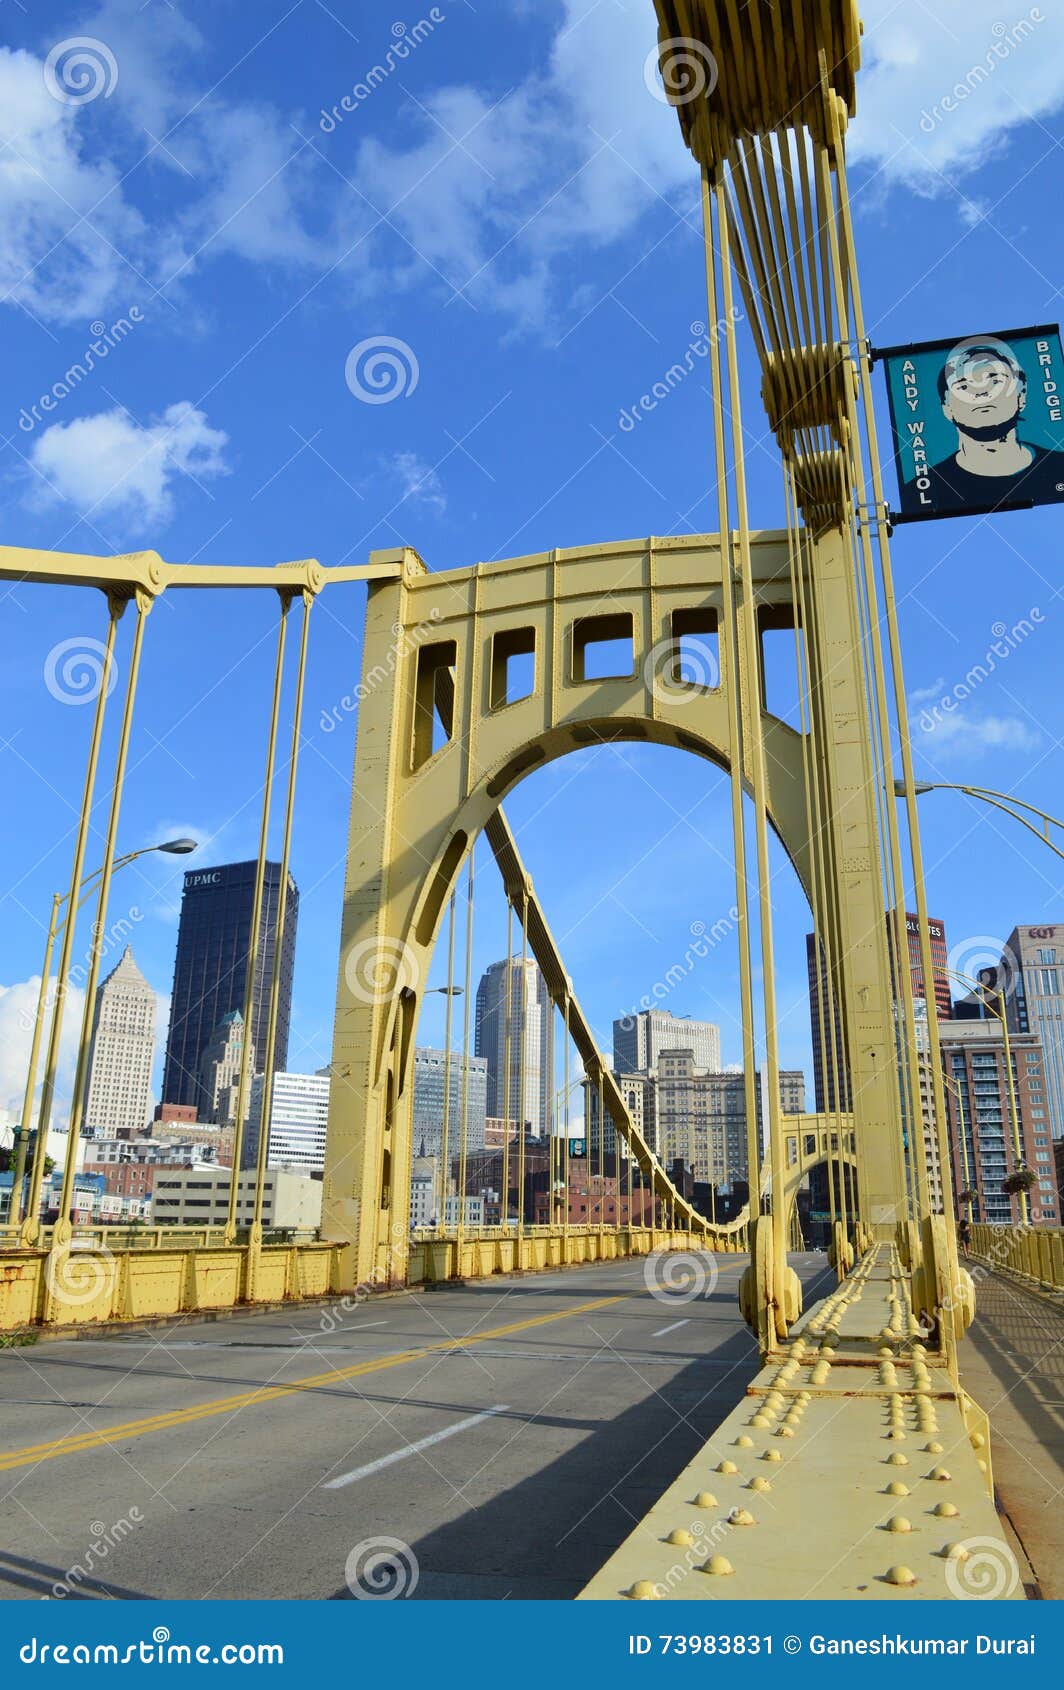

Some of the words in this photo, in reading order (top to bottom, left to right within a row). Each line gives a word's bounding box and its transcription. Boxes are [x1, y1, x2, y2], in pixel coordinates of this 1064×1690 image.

[902, 360, 920, 412] ANDY
[1036, 341, 1062, 421] BRIDGE
[907, 421, 932, 505] WARHOL
[184, 872, 221, 888] UPMC
